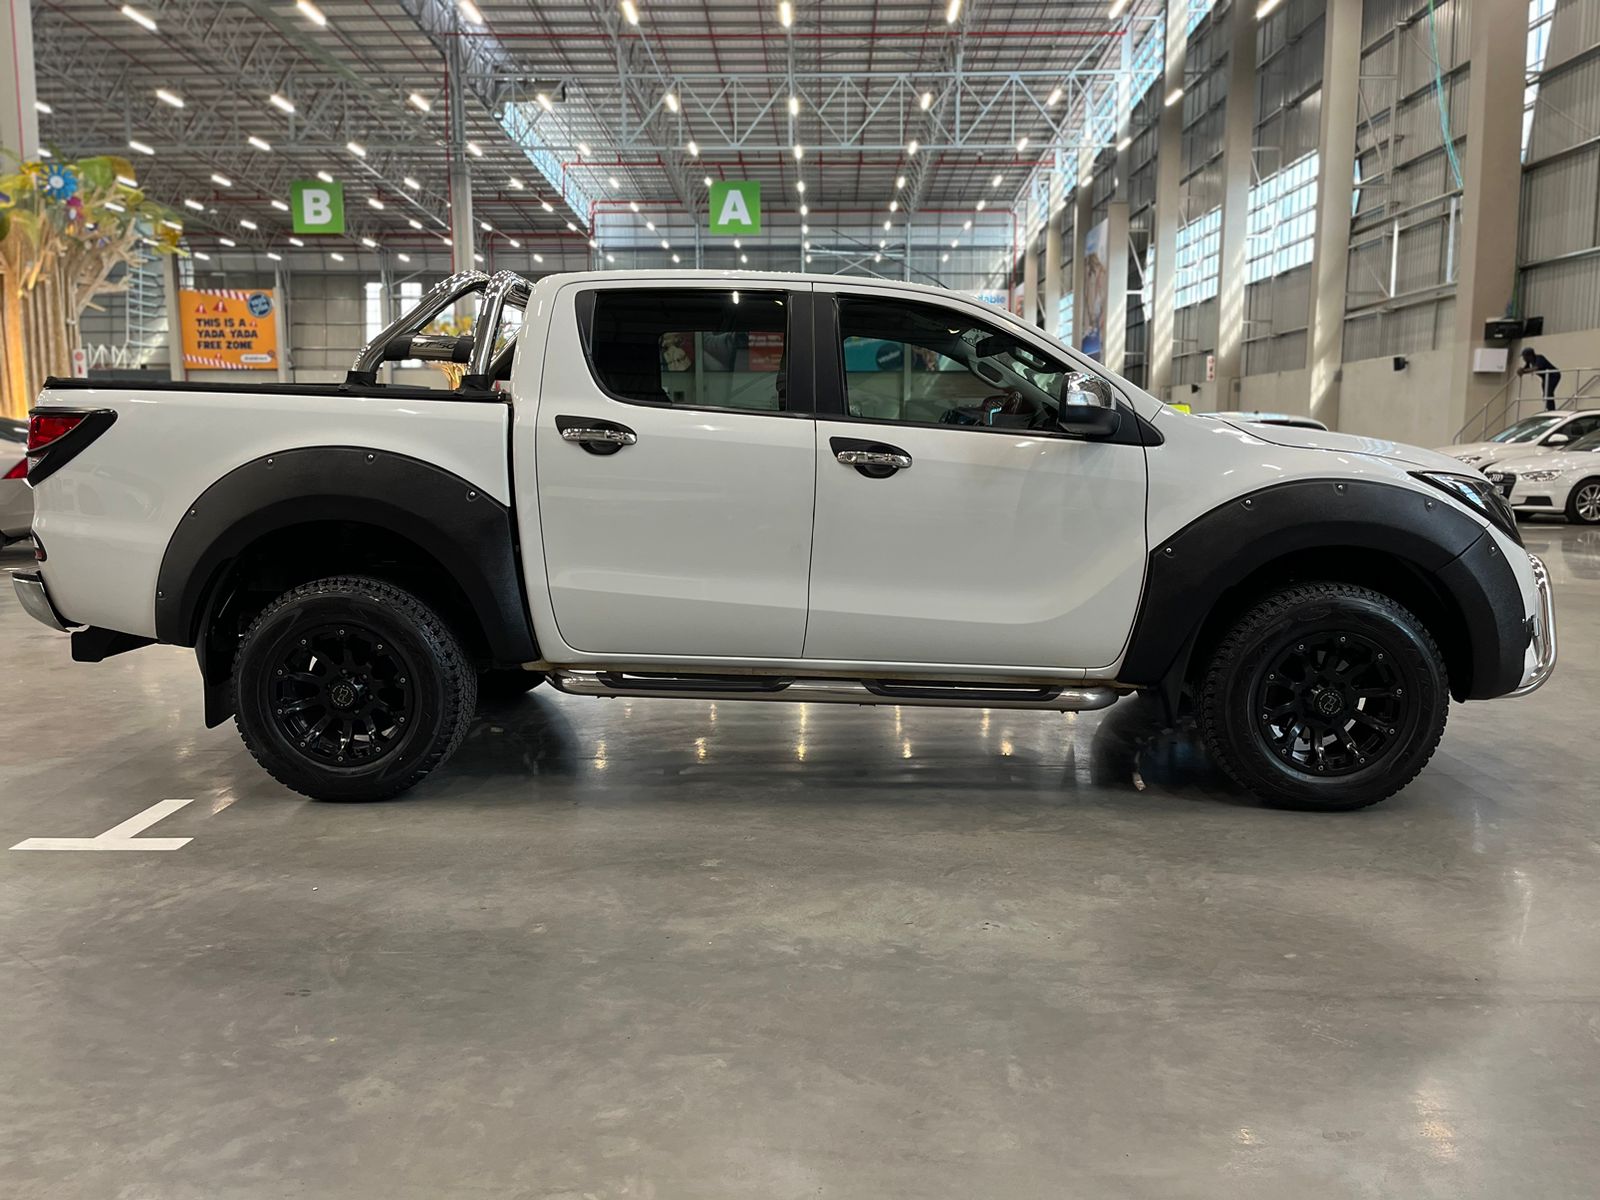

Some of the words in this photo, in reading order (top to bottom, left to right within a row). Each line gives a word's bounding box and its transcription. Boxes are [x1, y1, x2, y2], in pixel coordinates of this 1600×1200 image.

[303, 189, 332, 224] B
[718, 190, 752, 225] A
[196, 319, 220, 327] THIS
[225, 319, 234, 327] IS
[239, 319, 246, 327] A
[197, 330, 225, 338] YADA
[231, 330, 258, 338] YADA
[197, 341, 222, 349] FREE
[226, 341, 252, 349] ZONE
